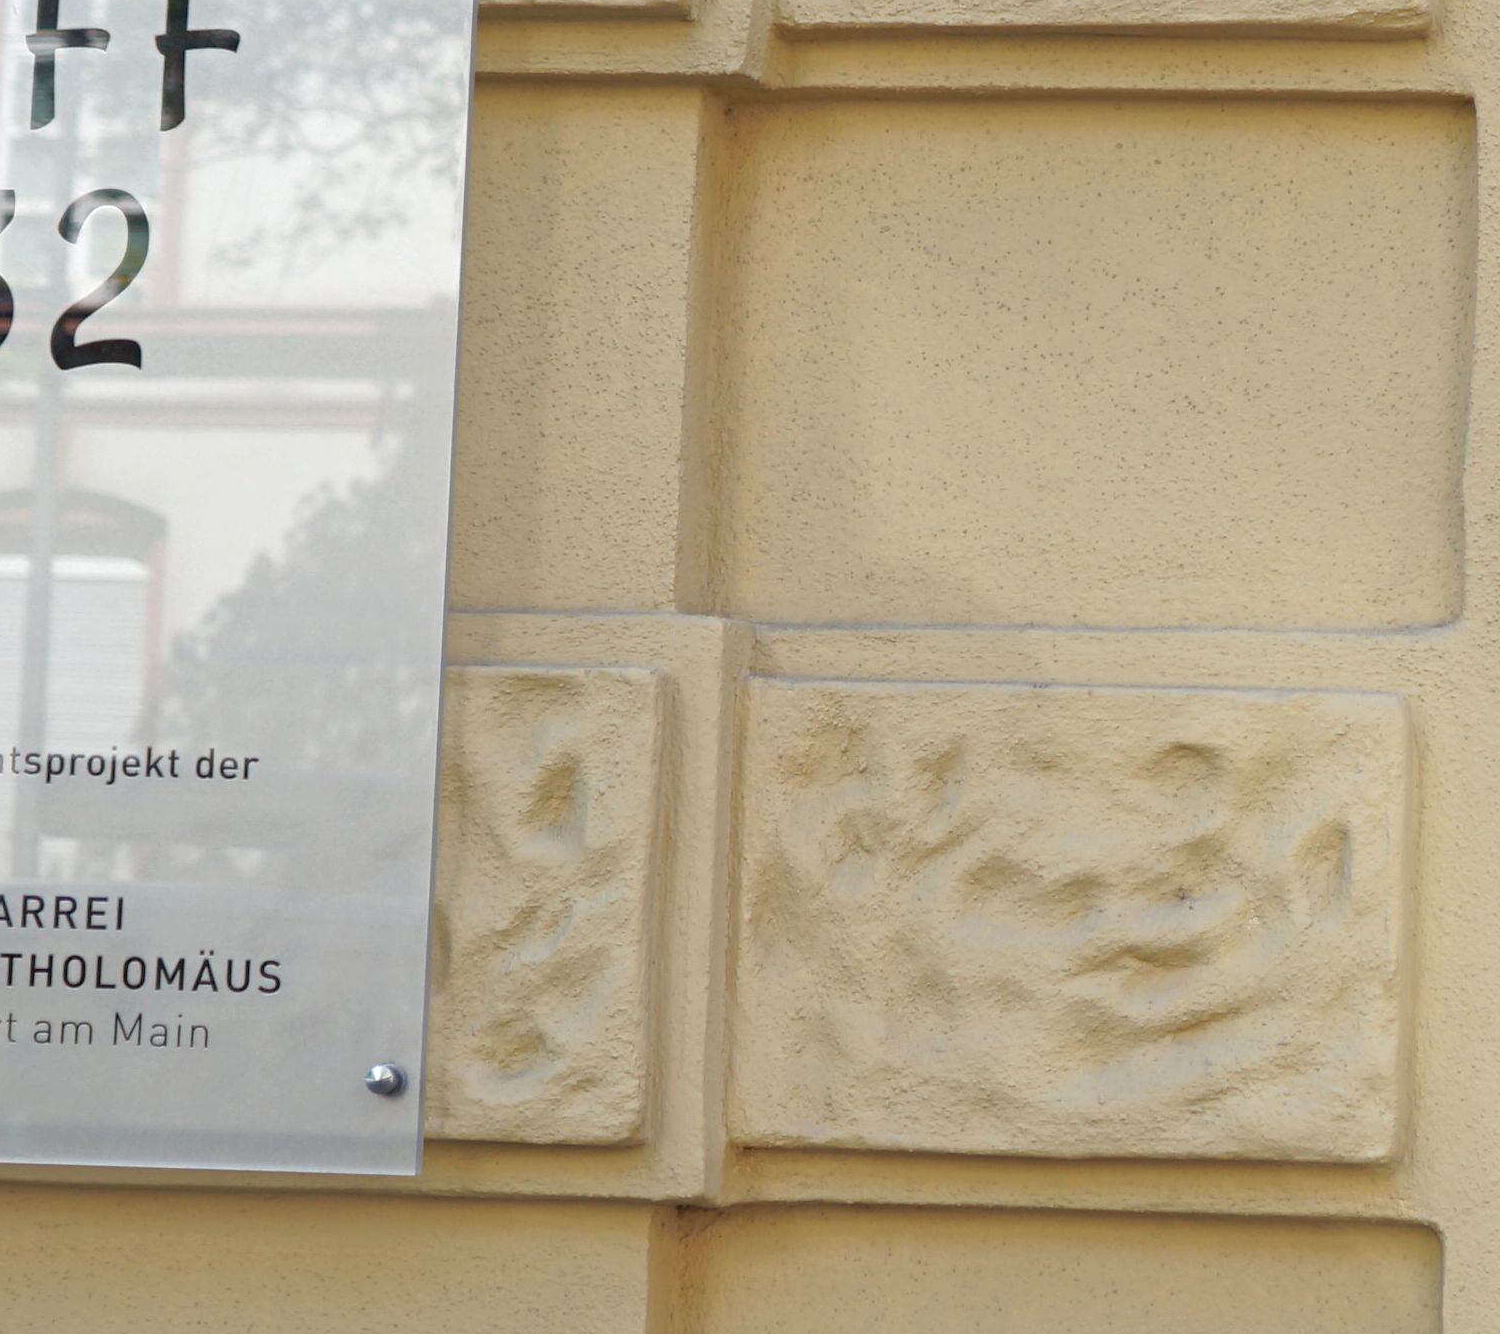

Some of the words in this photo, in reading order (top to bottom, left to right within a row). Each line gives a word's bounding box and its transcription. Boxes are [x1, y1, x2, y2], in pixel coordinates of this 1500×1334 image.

[195, 747, 260, 781] der
[33, 1018, 94, 1046] am
[112, 1011, 210, 1049] Main
